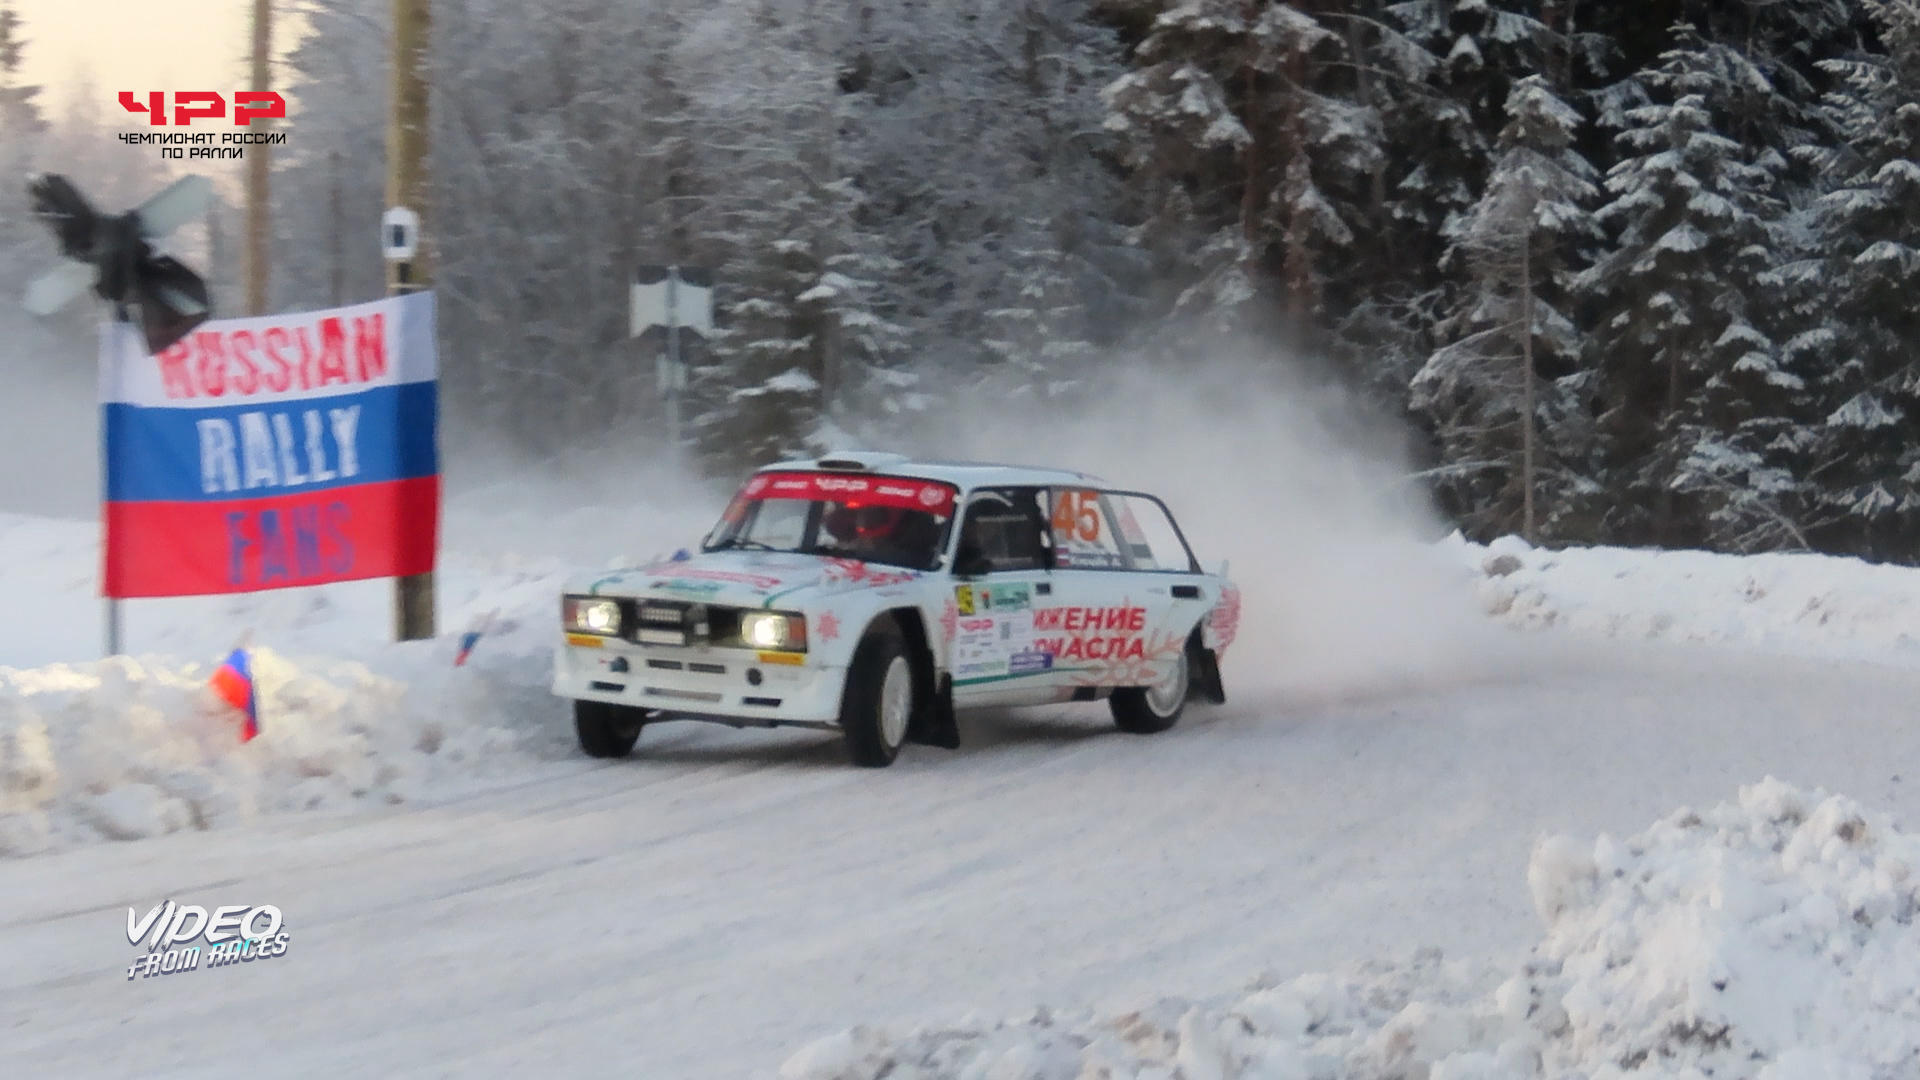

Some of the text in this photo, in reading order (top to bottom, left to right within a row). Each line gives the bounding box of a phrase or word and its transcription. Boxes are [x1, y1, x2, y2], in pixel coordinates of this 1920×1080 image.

[158, 313, 388, 400] RUSSIAN
[196, 405, 361, 494] RALLY
[226, 501, 356, 585] FANS
[1052, 490, 1100, 542] 45
